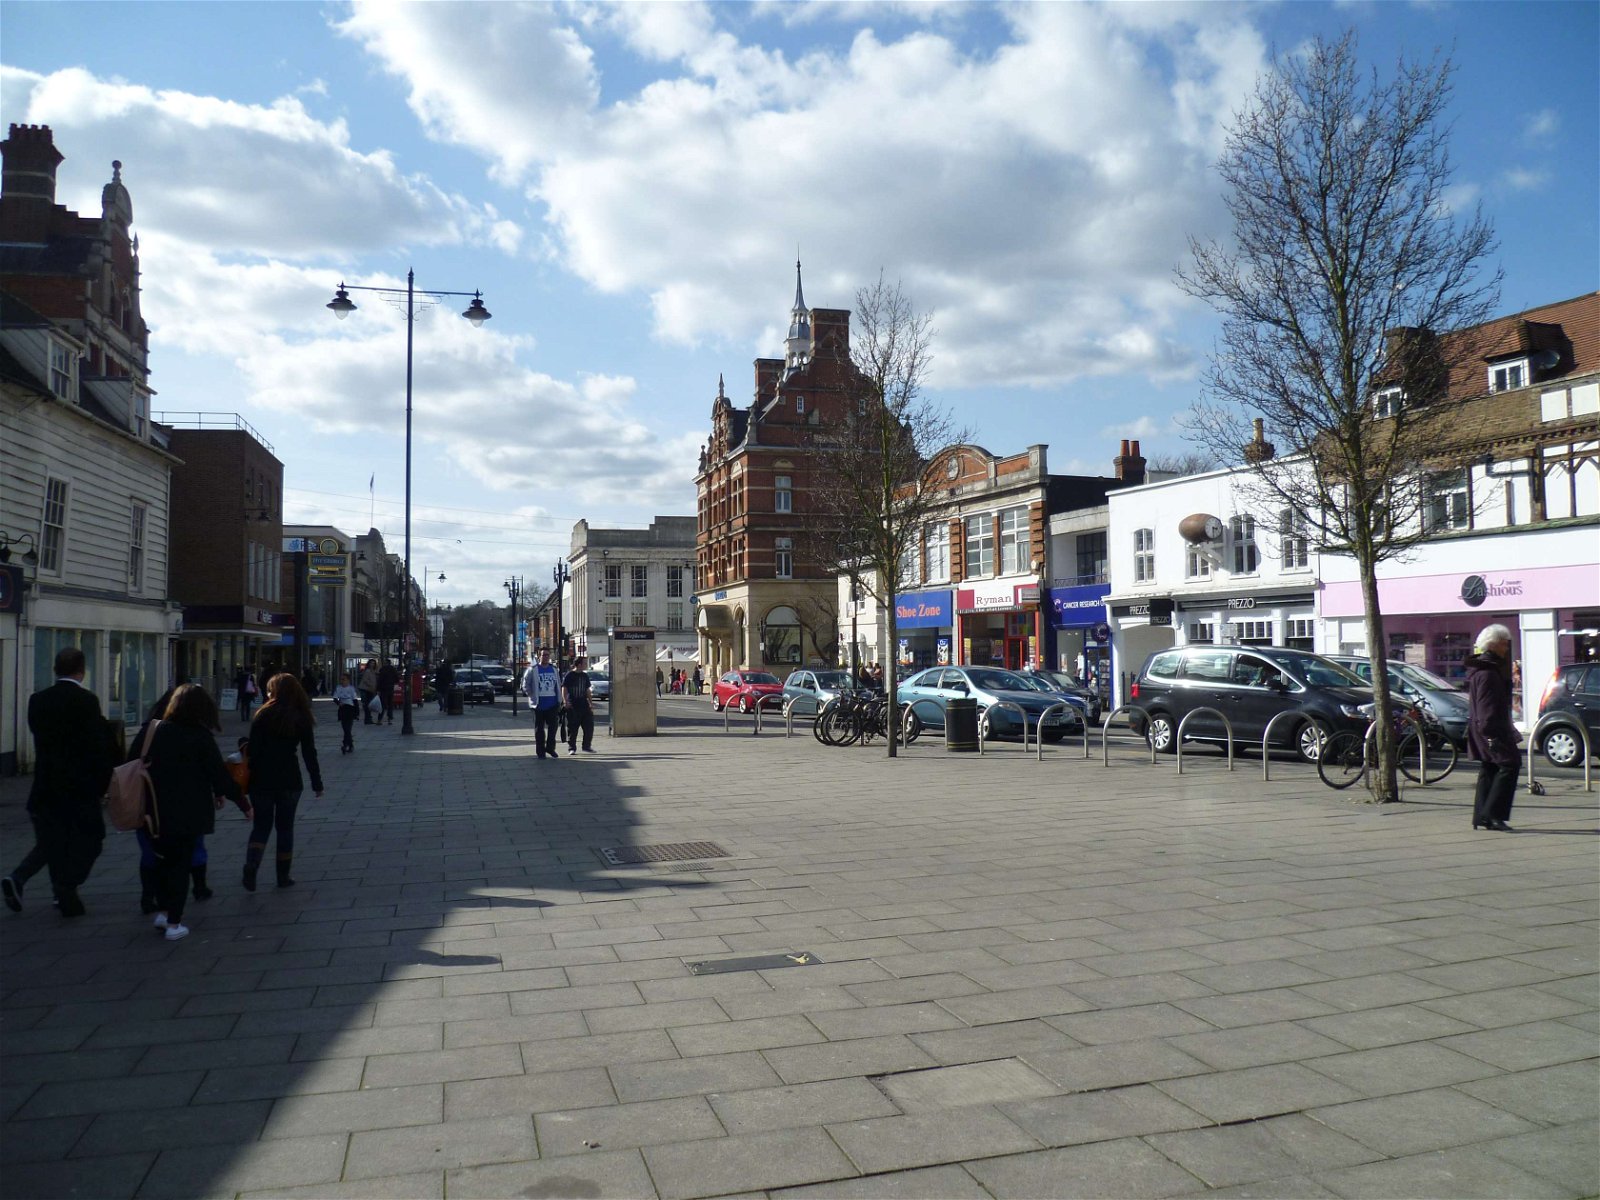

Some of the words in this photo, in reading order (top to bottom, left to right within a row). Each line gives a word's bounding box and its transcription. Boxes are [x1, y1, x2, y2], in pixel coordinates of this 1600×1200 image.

[976, 595, 1012, 606] Ryman
[1079, 600, 1100, 608] RESEARCH
[1227, 598, 1255, 610] PREZZO
[896, 605, 917, 618] Shoe
[918, 603, 941, 617] Zone
